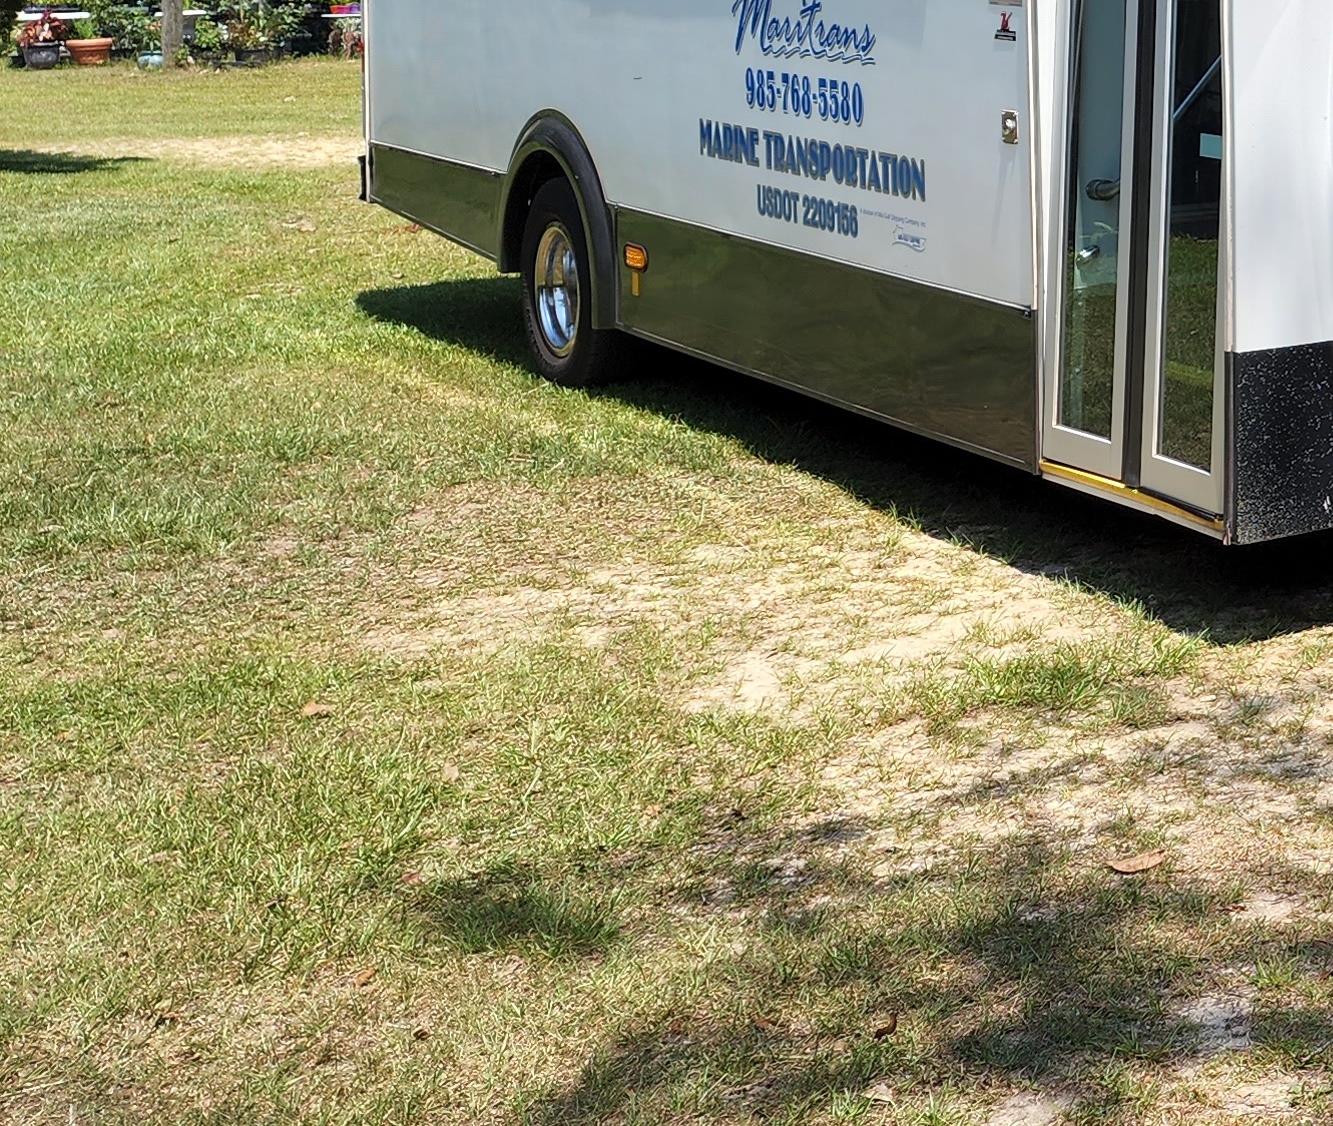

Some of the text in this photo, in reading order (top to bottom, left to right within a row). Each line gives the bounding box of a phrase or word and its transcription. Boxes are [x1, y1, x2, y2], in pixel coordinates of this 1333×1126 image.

[745, 67, 865, 126] 985-768-5580
[699, 117, 926, 202] MARINE TRANSPORTATION
[757, 183, 859, 239] USDOT 2209156
